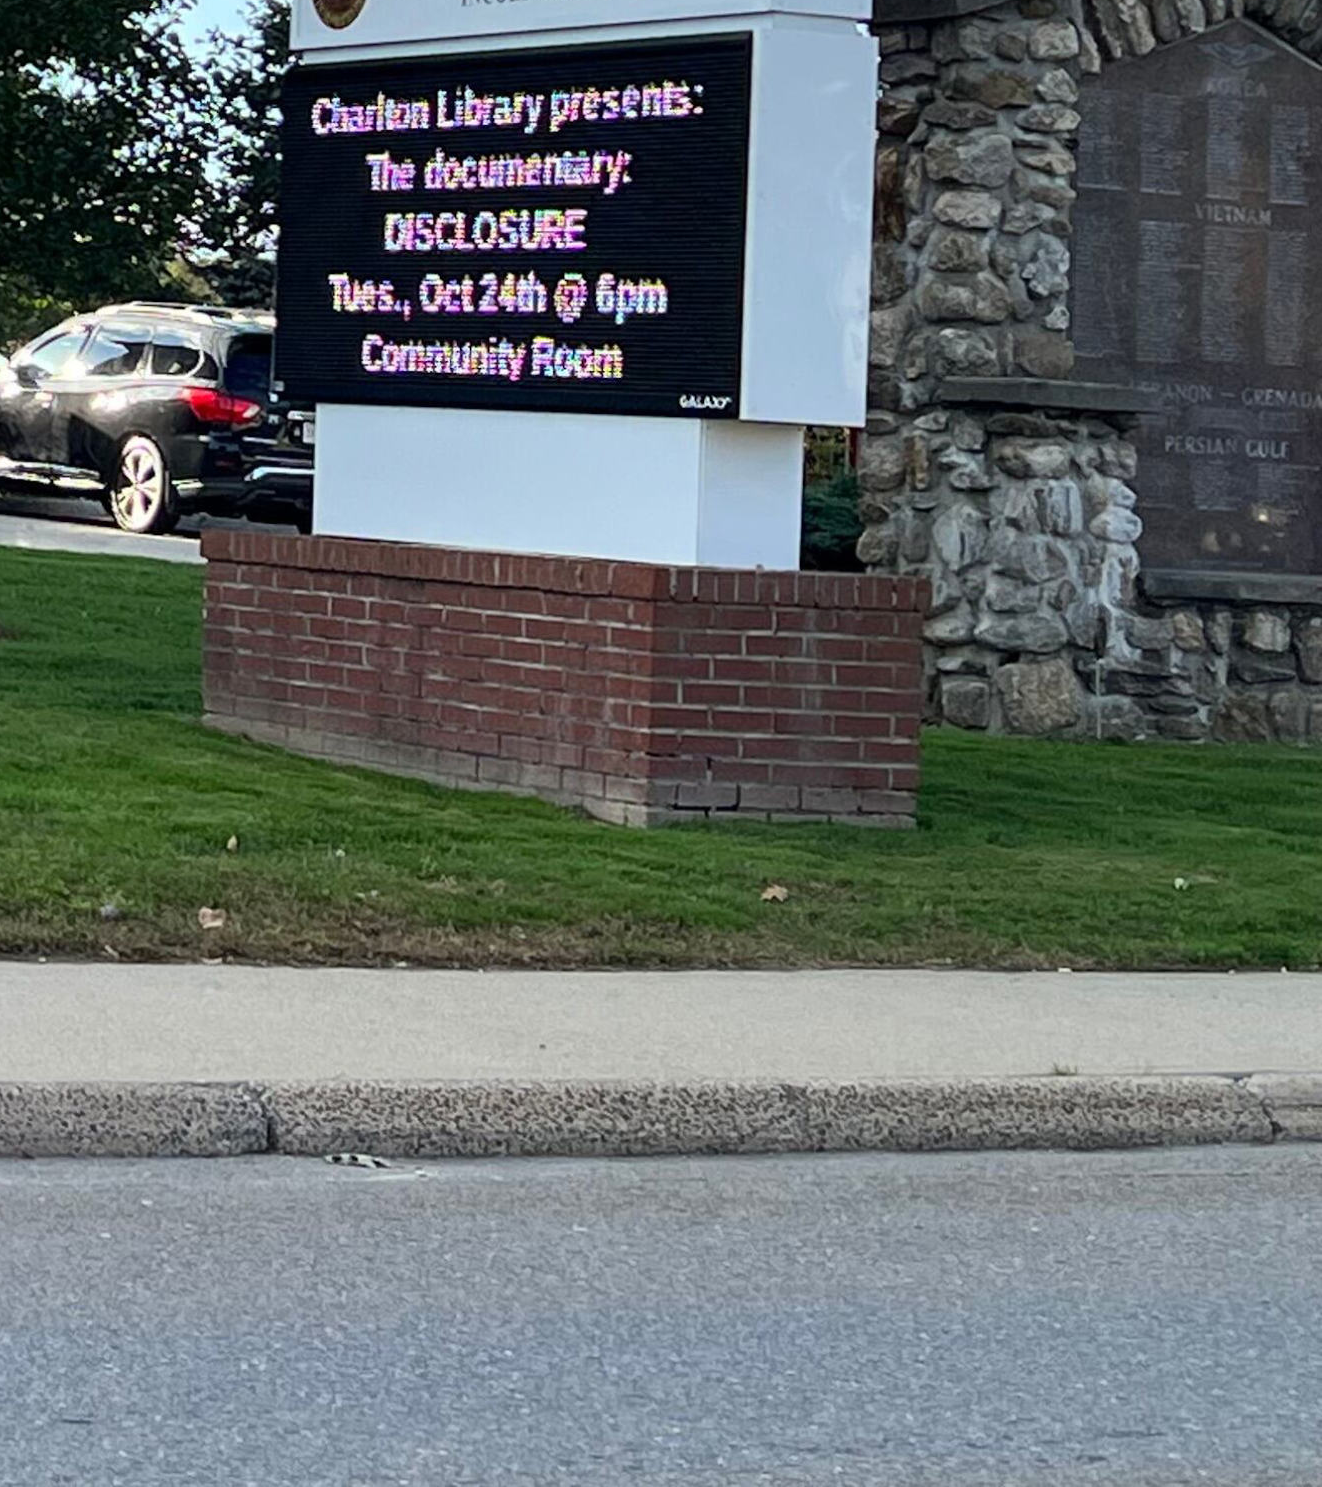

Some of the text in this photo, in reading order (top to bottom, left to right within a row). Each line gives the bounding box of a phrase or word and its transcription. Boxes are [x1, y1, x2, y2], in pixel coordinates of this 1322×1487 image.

[311, 80, 704, 135] Charlton Library presents:
[365, 150, 416, 192] The
[383, 208, 588, 251] DISCLOSURE
[1194, 203, 1272, 226] VIETNAM
[419, 273, 474, 313] Oct
[477, 270, 548, 314] 24th
[553, 272, 588, 324] @
[595, 272, 669, 325] 6pm
[360, 333, 624, 382] Community Room
[1164, 434, 1290, 459] PERSIAN GULF
